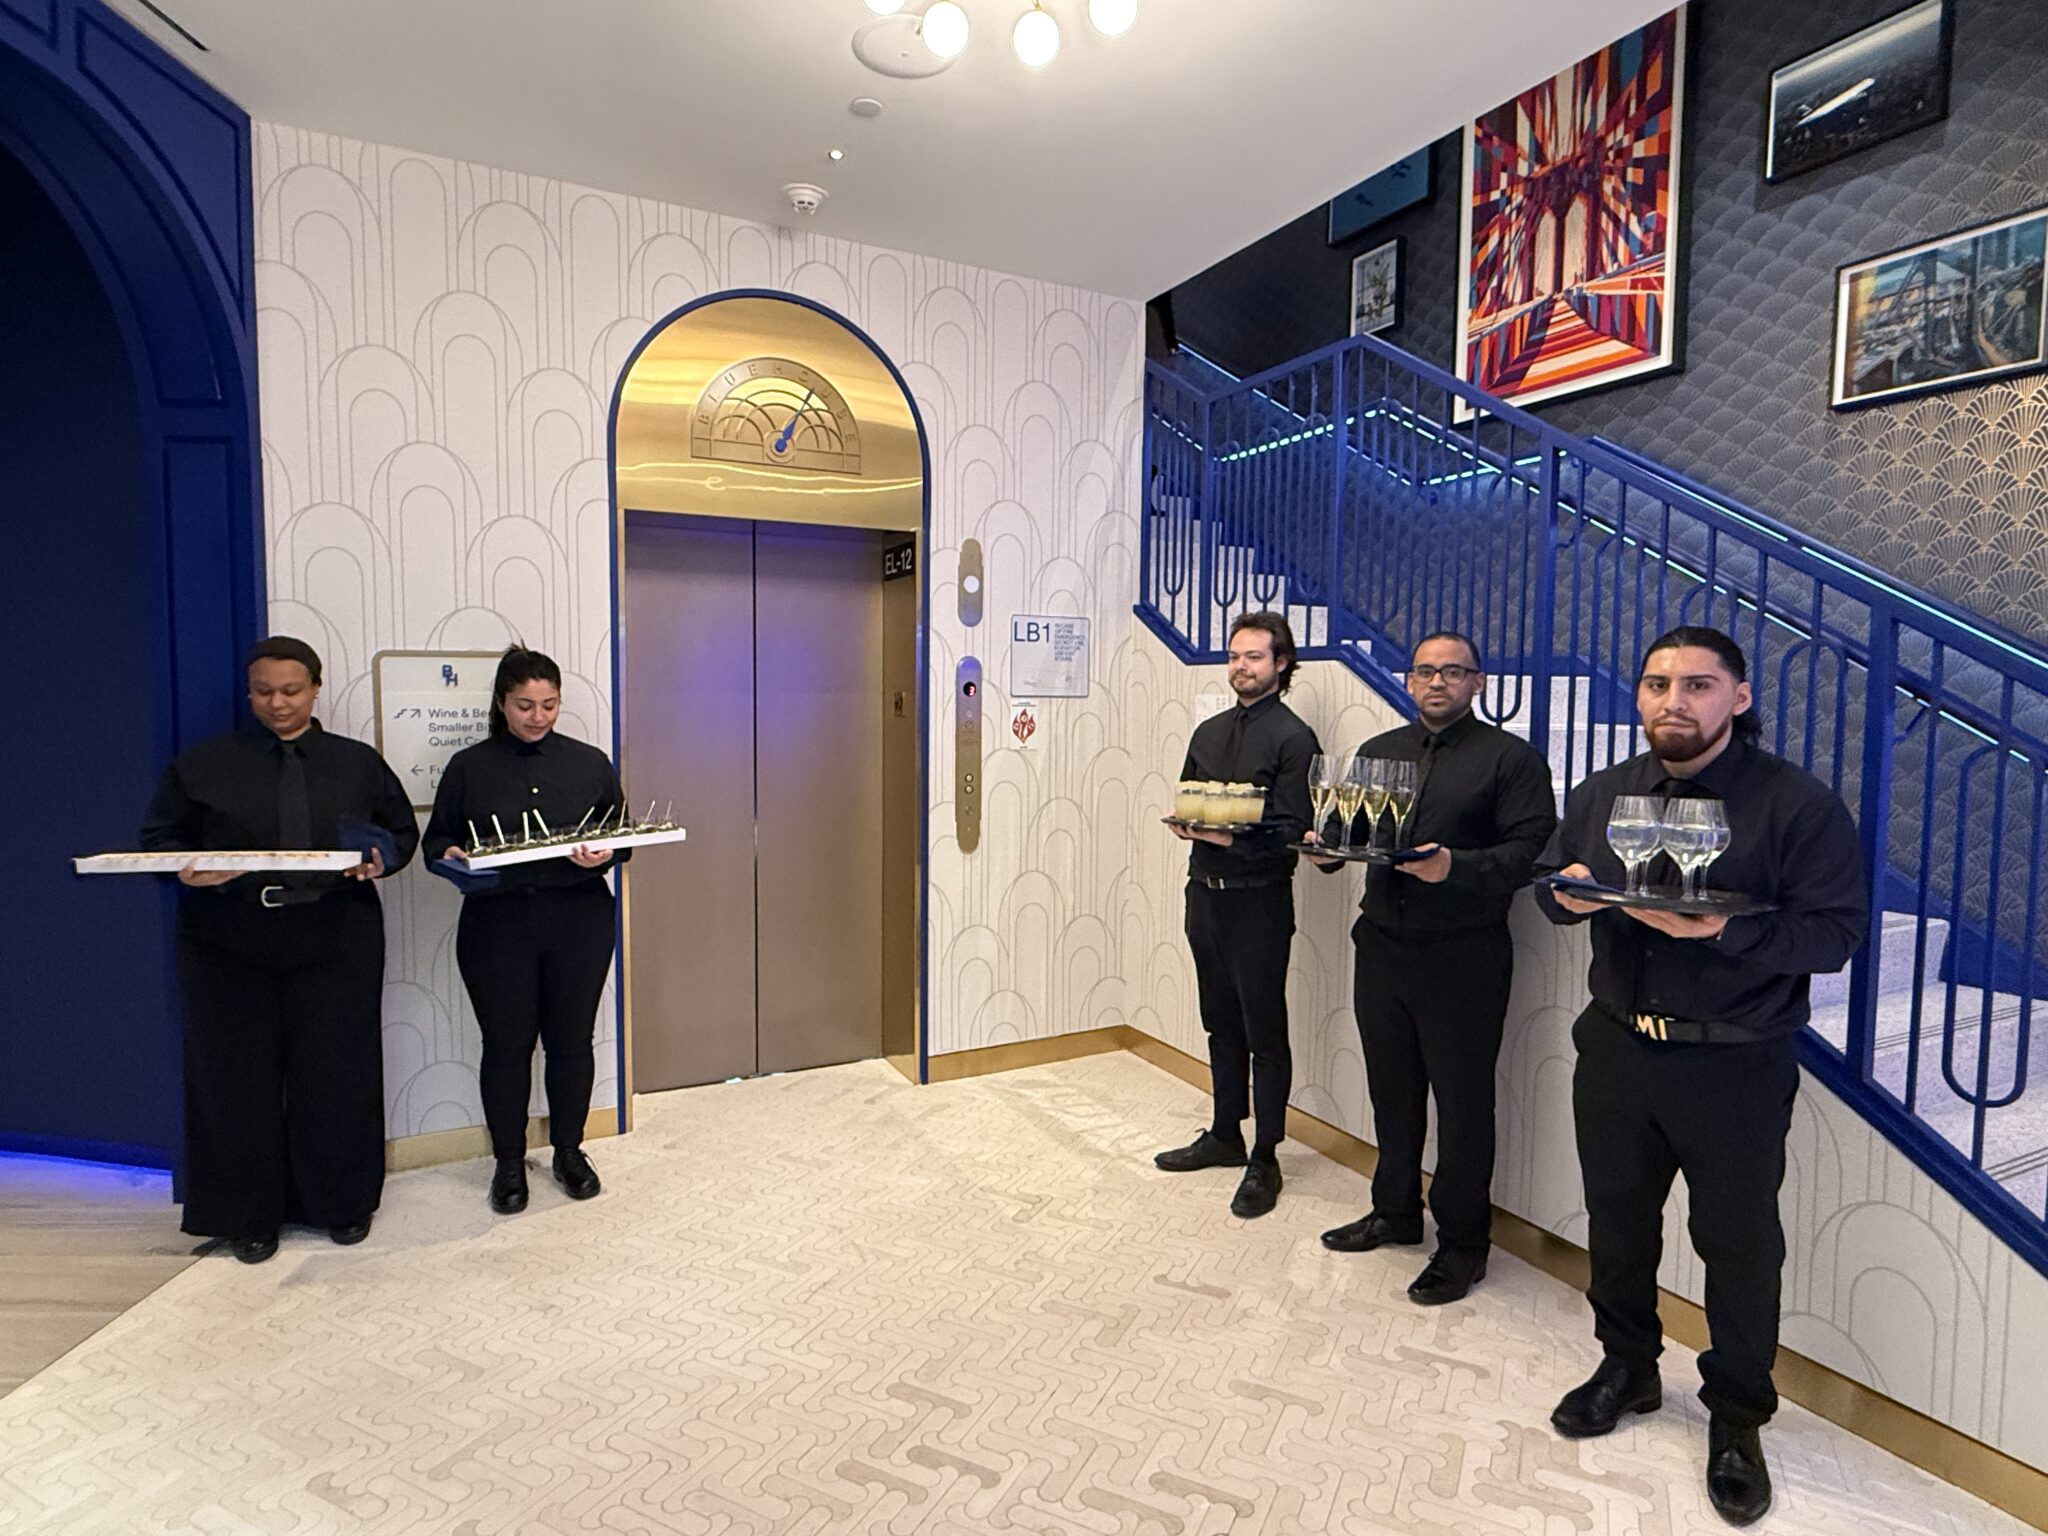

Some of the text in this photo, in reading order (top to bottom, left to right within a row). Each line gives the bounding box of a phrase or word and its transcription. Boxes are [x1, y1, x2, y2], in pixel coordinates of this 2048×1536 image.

[885, 548, 913, 575] EL-12
[1014, 621, 1050, 643] LB1
[428, 708, 458, 718] Wine
[461, 708, 469, 718] &
[428, 722, 473, 732] Smaller
[428, 736, 461, 747] Quiet
